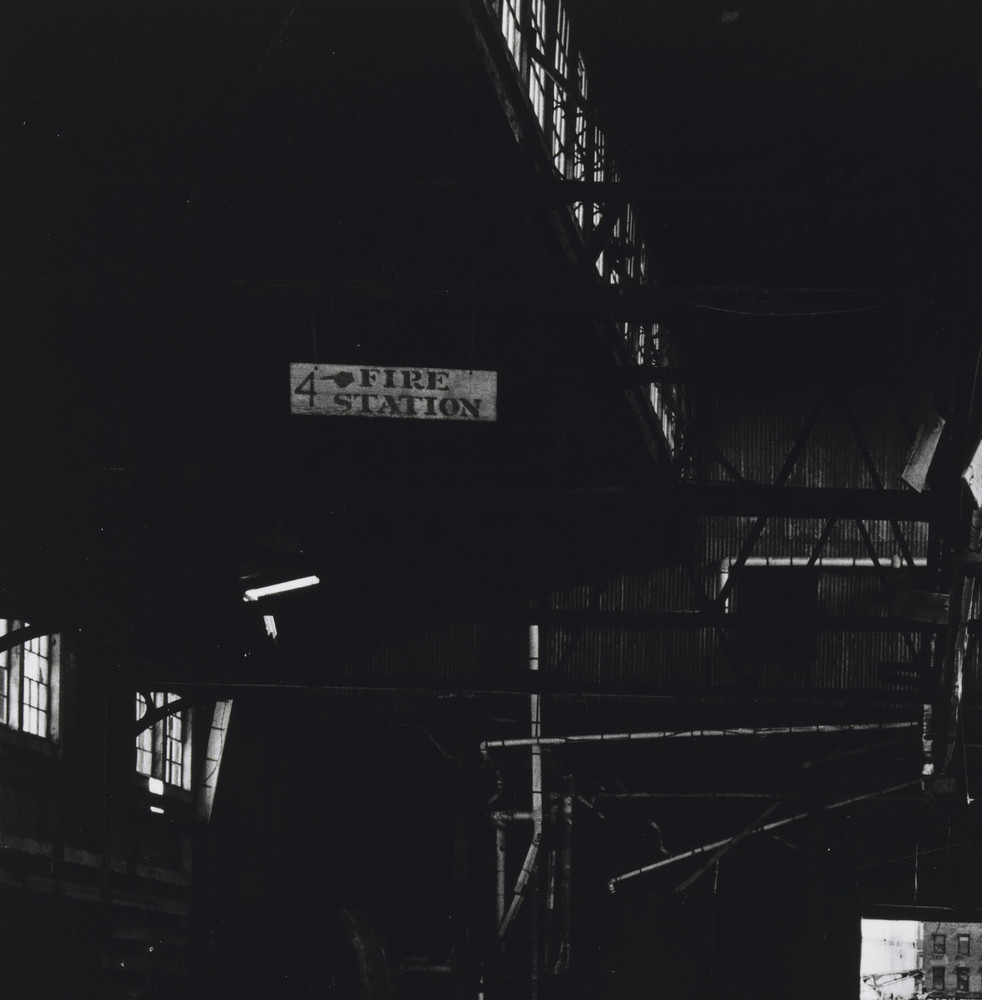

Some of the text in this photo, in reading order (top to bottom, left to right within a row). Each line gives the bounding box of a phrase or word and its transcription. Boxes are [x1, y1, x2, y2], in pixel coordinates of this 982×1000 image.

[294, 368, 449, 407] 4 FIRE
[333, 393, 481, 417] STATION
